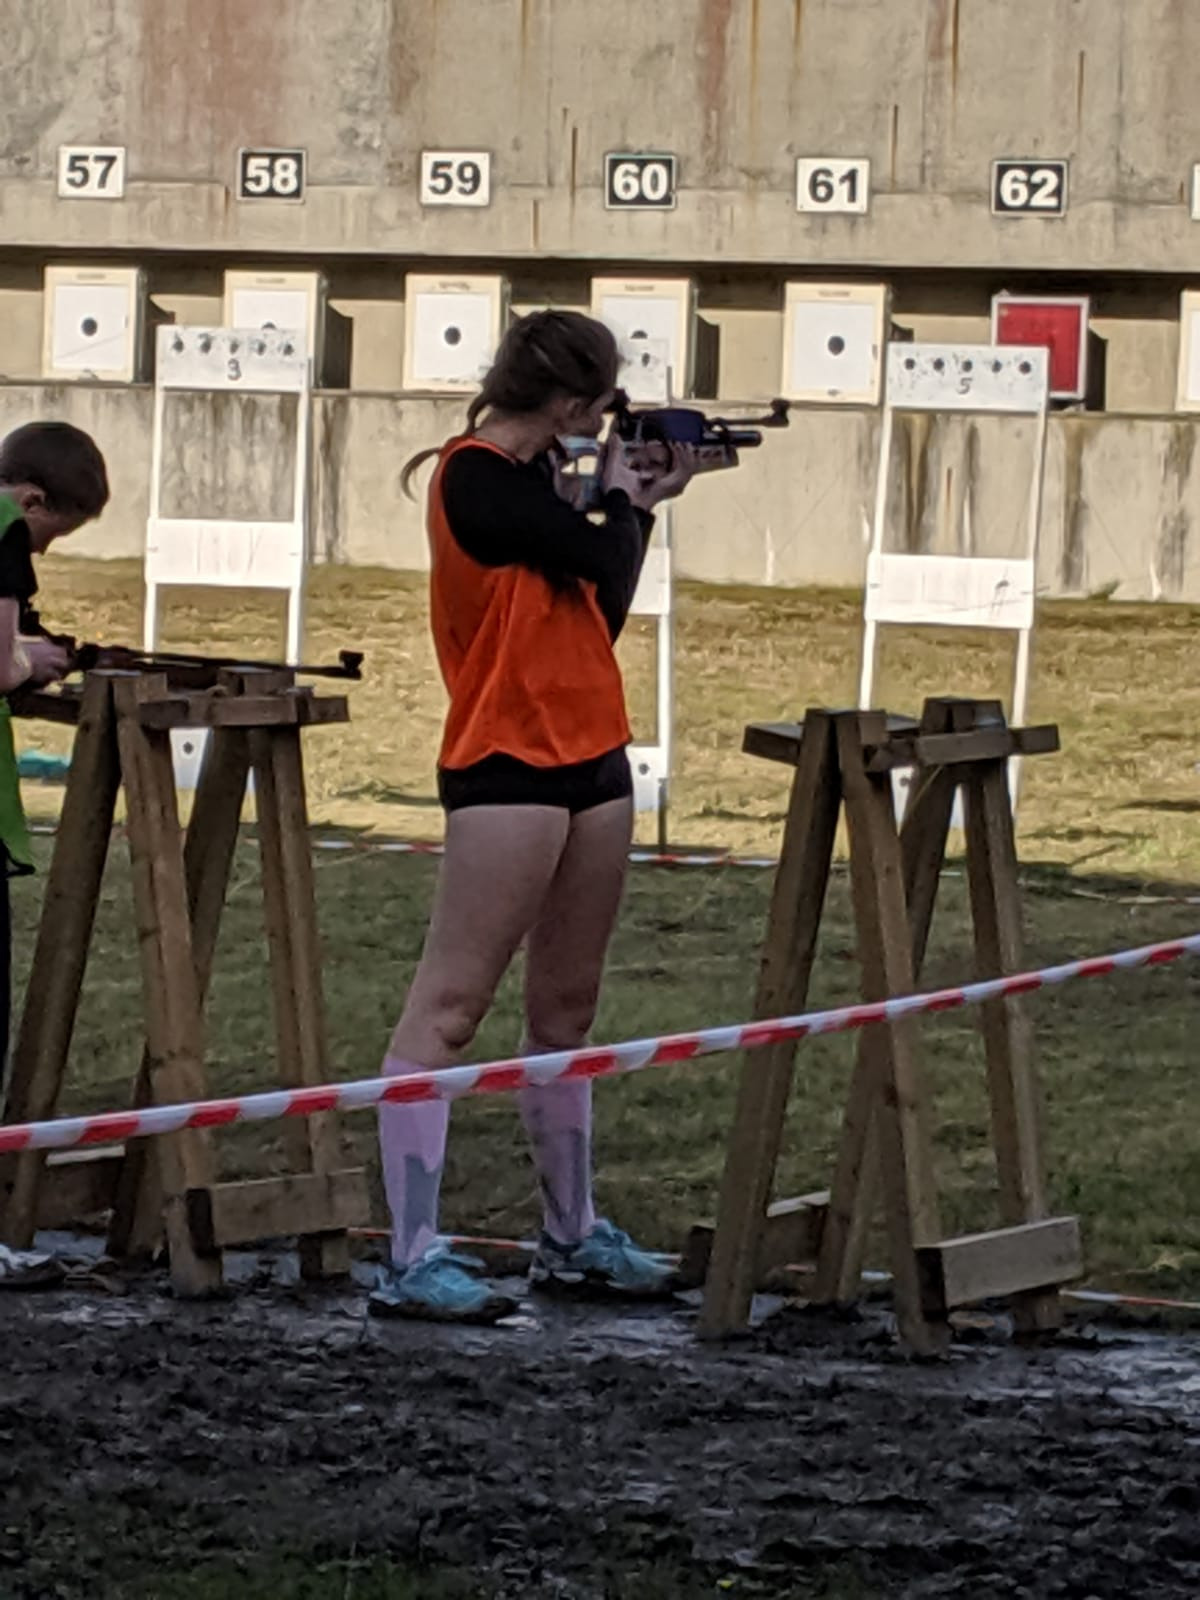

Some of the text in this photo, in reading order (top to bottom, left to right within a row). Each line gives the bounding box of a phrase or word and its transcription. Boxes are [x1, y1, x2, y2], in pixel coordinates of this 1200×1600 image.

[65, 154, 118, 189] 57
[243, 158, 299, 194] 58
[428, 161, 482, 195] 59
[612, 164, 668, 201] 60
[808, 168, 859, 204] 61
[999, 169, 1059, 207] 62
[227, 358, 242, 381] 3
[957, 377, 973, 396] 5
